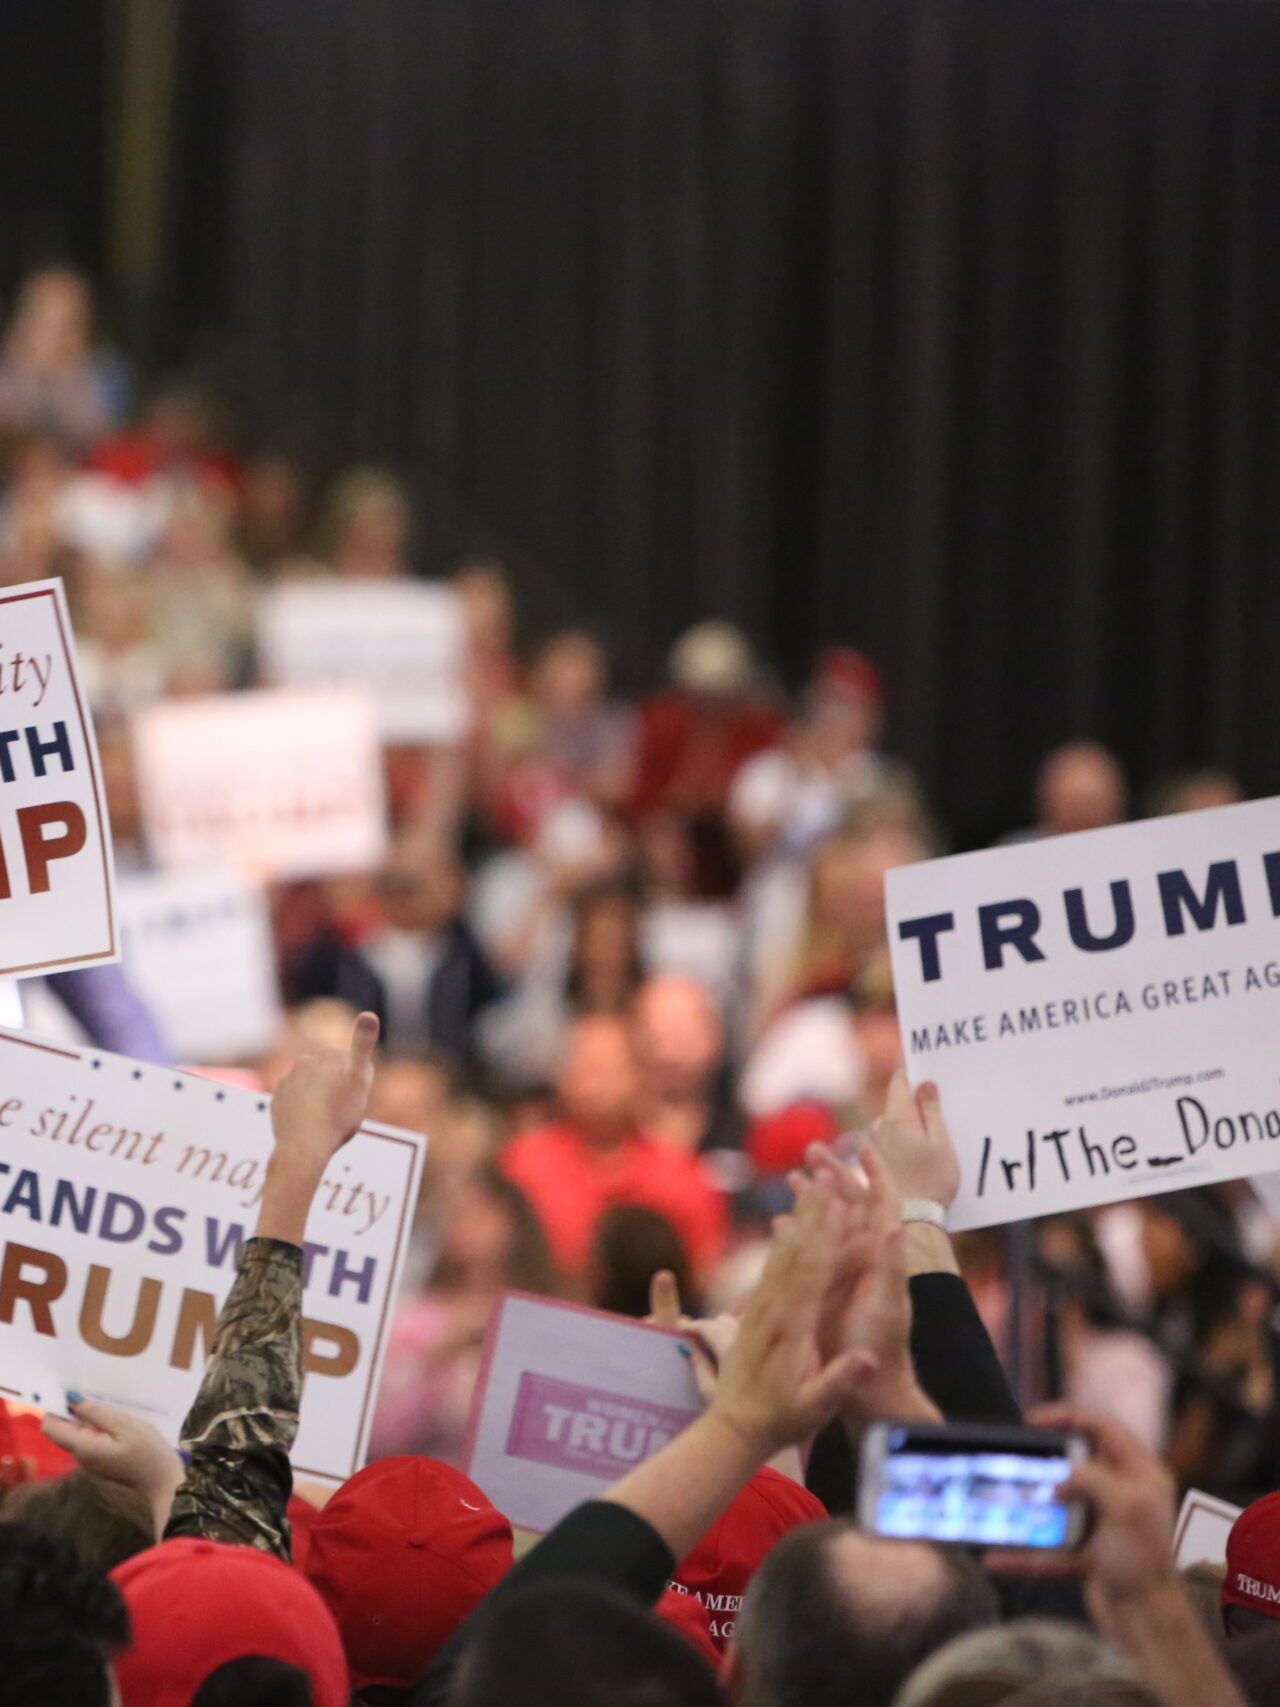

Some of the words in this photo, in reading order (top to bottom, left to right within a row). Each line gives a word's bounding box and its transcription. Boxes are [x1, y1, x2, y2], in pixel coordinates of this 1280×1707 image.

[911, 1015, 988, 1054] MAKE
[998, 991, 1133, 1039] AMERICA
[1142, 969, 1232, 1011] GREAT
[30, 1094, 167, 1166] silent
[176, 1143, 392, 1236] maity
[204, 1216, 377, 1304] WTH
